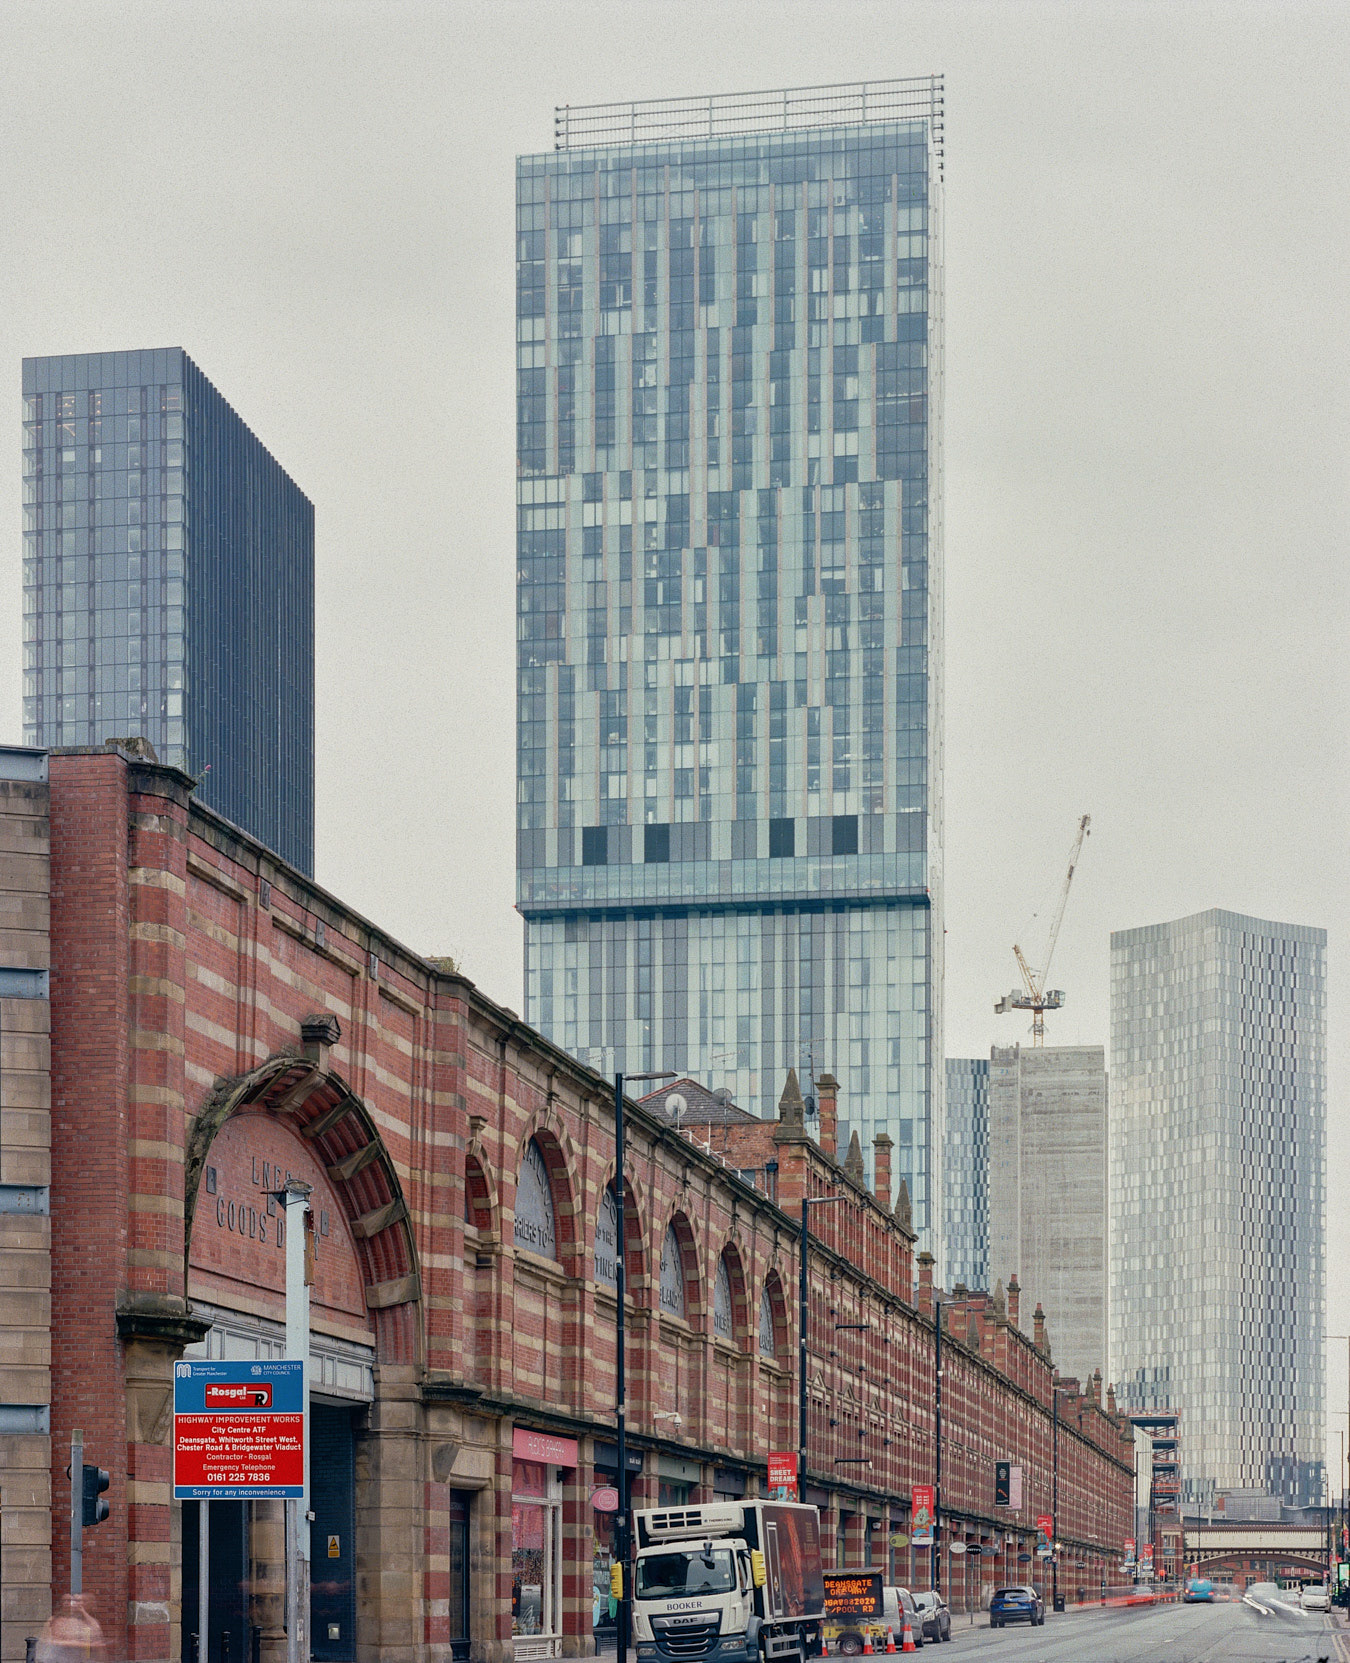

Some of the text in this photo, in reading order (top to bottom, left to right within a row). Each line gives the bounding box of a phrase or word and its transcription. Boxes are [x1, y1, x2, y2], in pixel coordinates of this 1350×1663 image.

[216, 1197, 267, 1243] GOODS
[211, 1386, 247, 1399] Rosgal
[178, 1415, 301, 1424] HIGHWAY IMPROVEMENT WORKS
[211, 1426, 226, 1434] City
[231, 1443, 274, 1452] Bridgewater
[274, 1443, 302, 1451] Viaduct
[248, 1453, 272, 1461] Rosgal
[202, 1463, 276, 1471] Emergency Telephone
[207, 1472, 271, 1481] 0161 225 7836
[192, 1488, 211, 1496] Sorry
[238, 1488, 286, 1496] inconvenience
[824, 1579, 873, 1589] DEANSGATE
[666, 1601, 703, 1611] BOOKER
[673, 1617, 700, 1625] DAF
